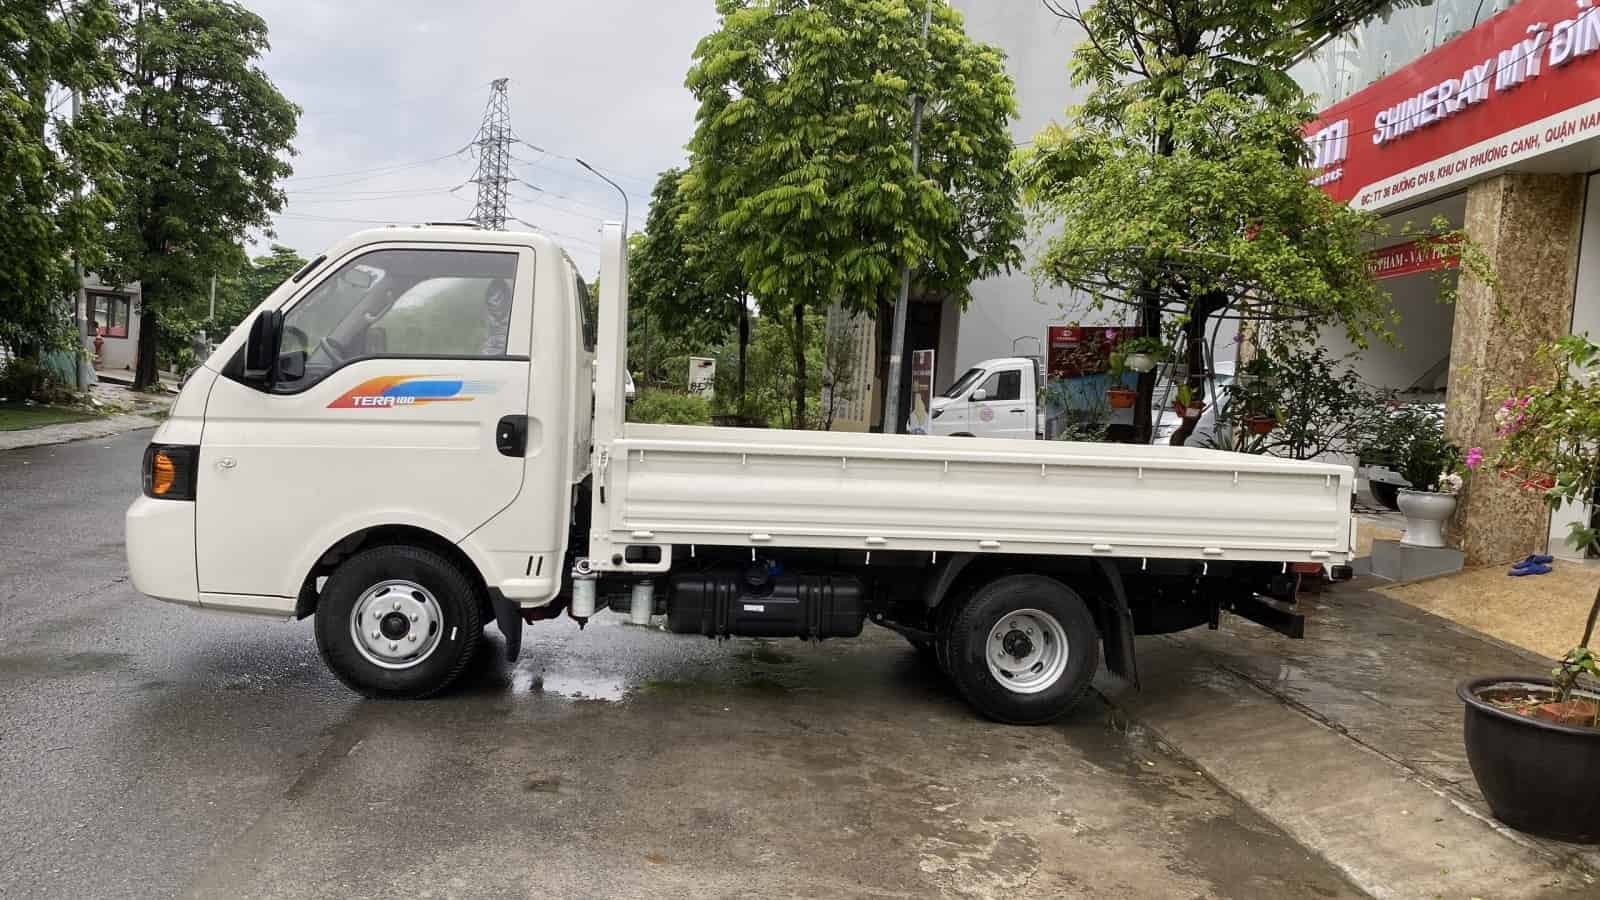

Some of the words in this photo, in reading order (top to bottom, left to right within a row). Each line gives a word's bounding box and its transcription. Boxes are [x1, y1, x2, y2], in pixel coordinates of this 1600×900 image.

[1373, 58, 1496, 145] SHINERAY
[1496, 22, 1548, 92] MỸ
[1374, 190, 1383, 202] TT
[1418, 172, 1429, 186] CN
[1437, 162, 1455, 180] KHU
[1456, 159, 1469, 174] CN
[1470, 145, 1508, 168] PHƯƠNG
[1511, 134, 1541, 154] CANH,
[1545, 121, 1576, 143] QUẬN
[352, 396, 395, 406] TERA
